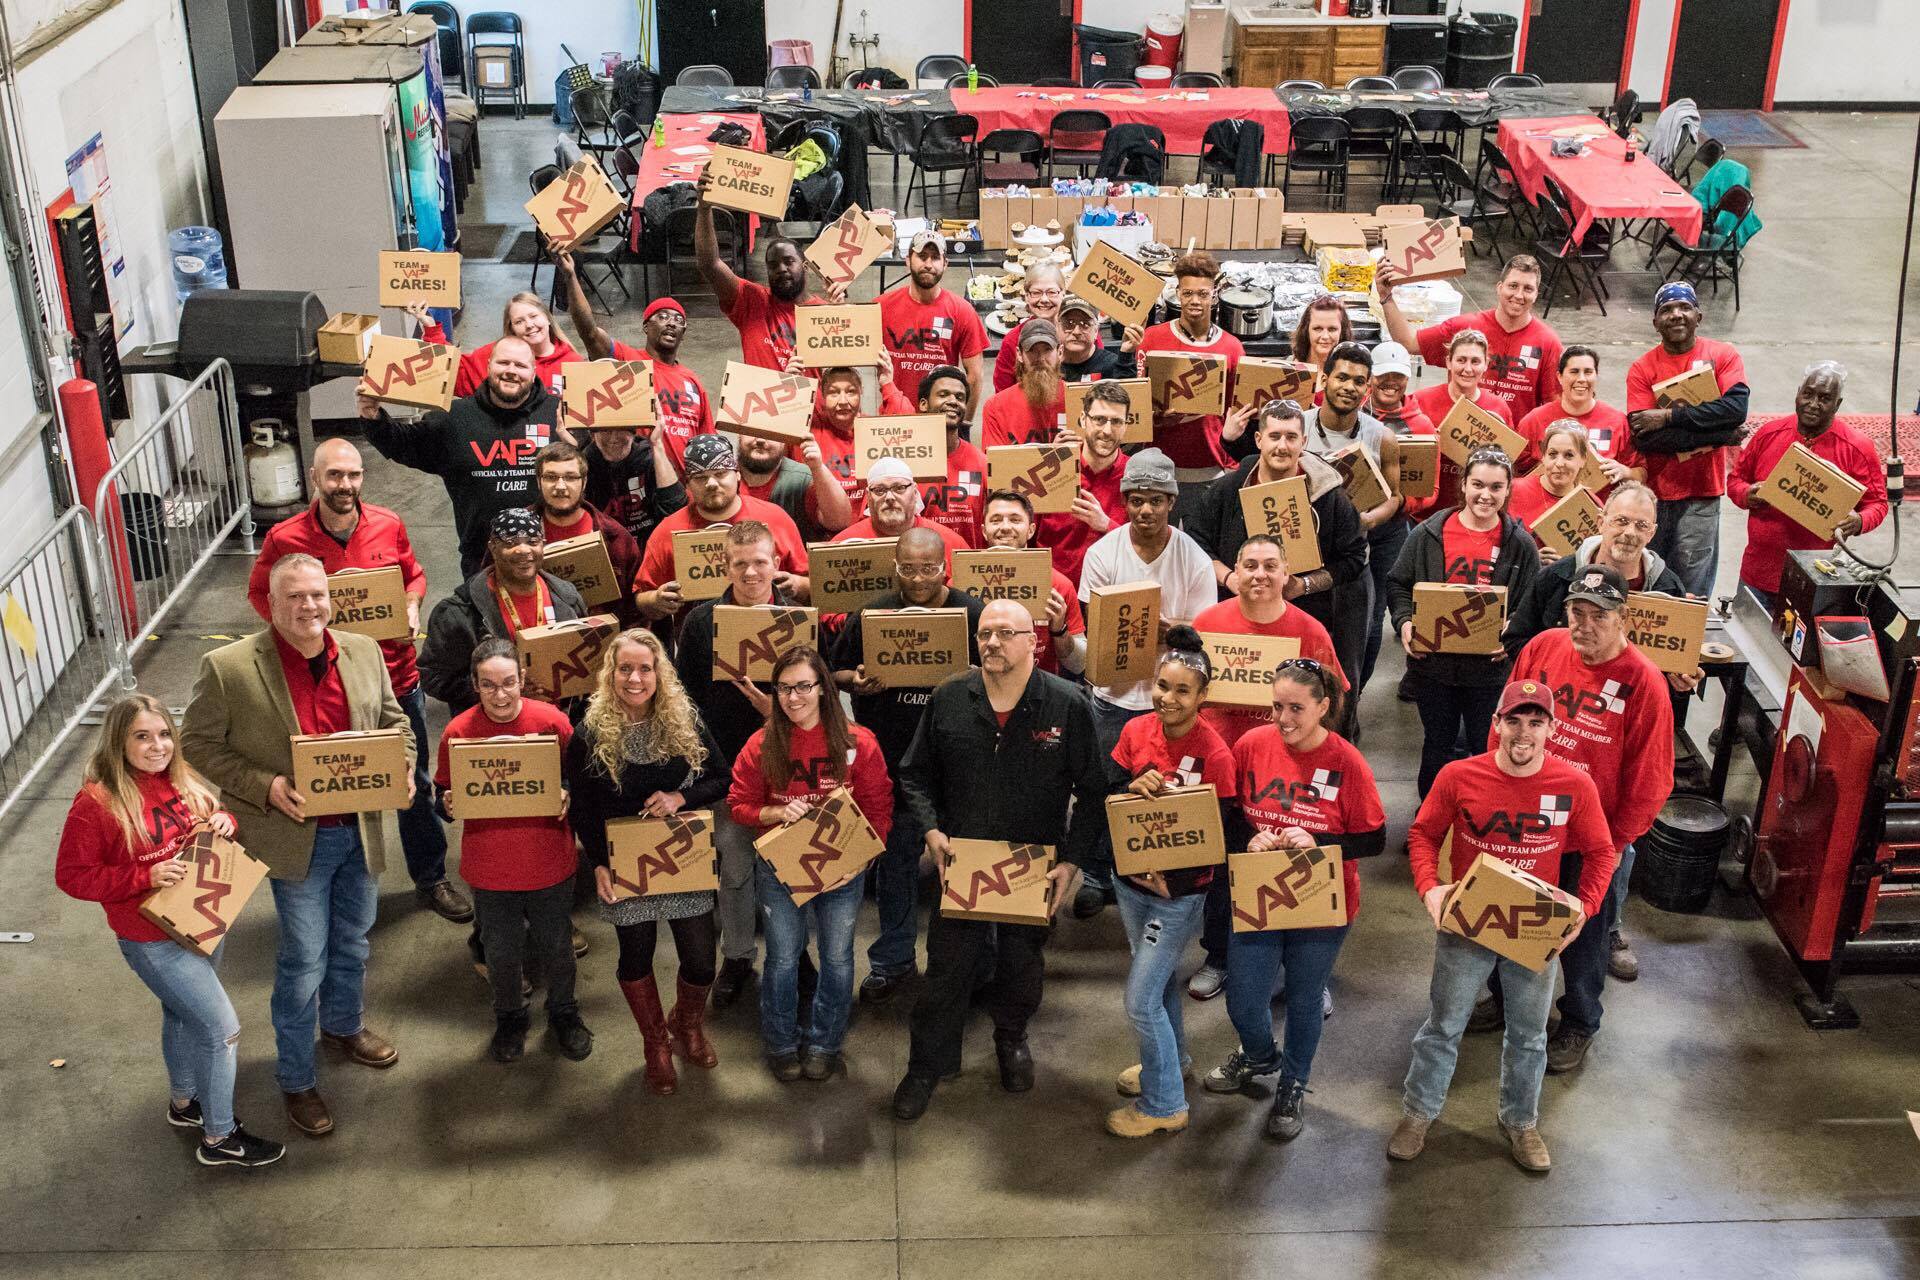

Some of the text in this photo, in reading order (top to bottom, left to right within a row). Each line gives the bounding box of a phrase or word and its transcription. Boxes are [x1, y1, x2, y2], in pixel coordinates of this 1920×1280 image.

[726, 157, 752, 170] TEAM
[733, 168, 757, 179] VAP
[718, 175, 775, 198] CARES!
[550, 173, 588, 242] VAP
[832, 219, 863, 282] VAP
[1391, 226, 1445, 276] VAP
[394, 261, 420, 269] TEAM
[402, 269, 424, 278] VAP
[1102, 256, 1126, 276] TEAM
[390, 278, 446, 290] CARES!
[1106, 269, 1128, 286] VAP
[1087, 271, 1140, 311] CARES!
[811, 317, 840, 326] TEAM
[822, 326, 846, 336] VAP
[886, 327, 940, 350] VAP
[808, 336, 870, 348] CARES!
[364, 349, 434, 396] VAP
[900, 362, 912, 370] WE
[568, 367, 636, 426] VAP
[724, 383, 798, 424] VAP
[870, 428, 901, 436] TEAM
[1466, 414, 1490, 434] TEAM
[882, 436, 908, 446] VAP
[1469, 426, 1492, 442] VAP
[470, 438, 537, 467] VAP
[867, 446, 933, 460] CARES!
[1012, 452, 1060, 498] AP
[1794, 463, 1821, 484] TEAM
[502, 480, 527, 491] CARE!
[1798, 476, 1825, 494] VAP
[1778, 477, 1834, 519] CARES!
[1279, 508, 1292, 535] VAP
[1288, 495, 1300, 532] TEAM
[1578, 508, 1600, 534] TEAM
[1577, 522, 1591, 539] VA
[690, 543, 723, 554] TEAM
[826, 558, 859, 568] TEAM
[970, 565, 1003, 574] TEAM
[838, 568, 866, 579] VAP
[982, 574, 1010, 585] VAP
[330, 587, 355, 599] EAM
[823, 577, 893, 593] CARES!
[966, 586, 1037, 600] CARES!
[335, 597, 362, 609] VAP
[327, 605, 393, 626] ARES!
[1141, 605, 1150, 636] TEAM
[1630, 608, 1655, 619] EAM
[1130, 617, 1142, 648] VAP
[1411, 600, 1486, 651] VAP
[1631, 618, 1660, 631] VAP
[880, 629, 915, 639] TEAM
[1115, 604, 1132, 670] CARES!
[1628, 630, 1686, 652] ARES!
[715, 618, 795, 680] VAP
[893, 639, 922, 650] VAP
[1213, 645, 1248, 656] TEAM
[877, 651, 952, 666] CARES!
[1224, 656, 1256, 668] VAP
[1210, 667, 1274, 685] CARES
[1562, 721, 1612, 744] TEAM MEMBER
[313, 754, 353, 766] TEAM
[469, 759, 506, 769] TEAM
[327, 762, 356, 776] VAP
[482, 769, 513, 781] VAP
[310, 774, 391, 793] CARES!
[466, 780, 544, 796] CARES!
[1247, 770, 1320, 811] VAP
[1293, 807, 1326, 819] Management
[1294, 802, 1320, 813] Packaging
[1127, 812, 1164, 824] TEAM
[1264, 810, 1278, 820] VAP
[1279, 814, 1299, 825] TEAM
[1300, 819, 1328, 831] MEMBER
[1458, 807, 1551, 843] VAP
[1140, 820, 1173, 834] VAP
[1126, 830, 1205, 851] CARES!
[1461, 832, 1560, 854] OFFICIAL VAP TEAM MEMBER
[614, 826, 694, 896] VAP
[790, 819, 842, 894] VAP
[1503, 858, 1536, 870] CARE!
[945, 854, 1031, 911] VAP
[193, 844, 232, 945] VAP
[1234, 859, 1312, 930] VAP
[1450, 904, 1551, 940] VAP
